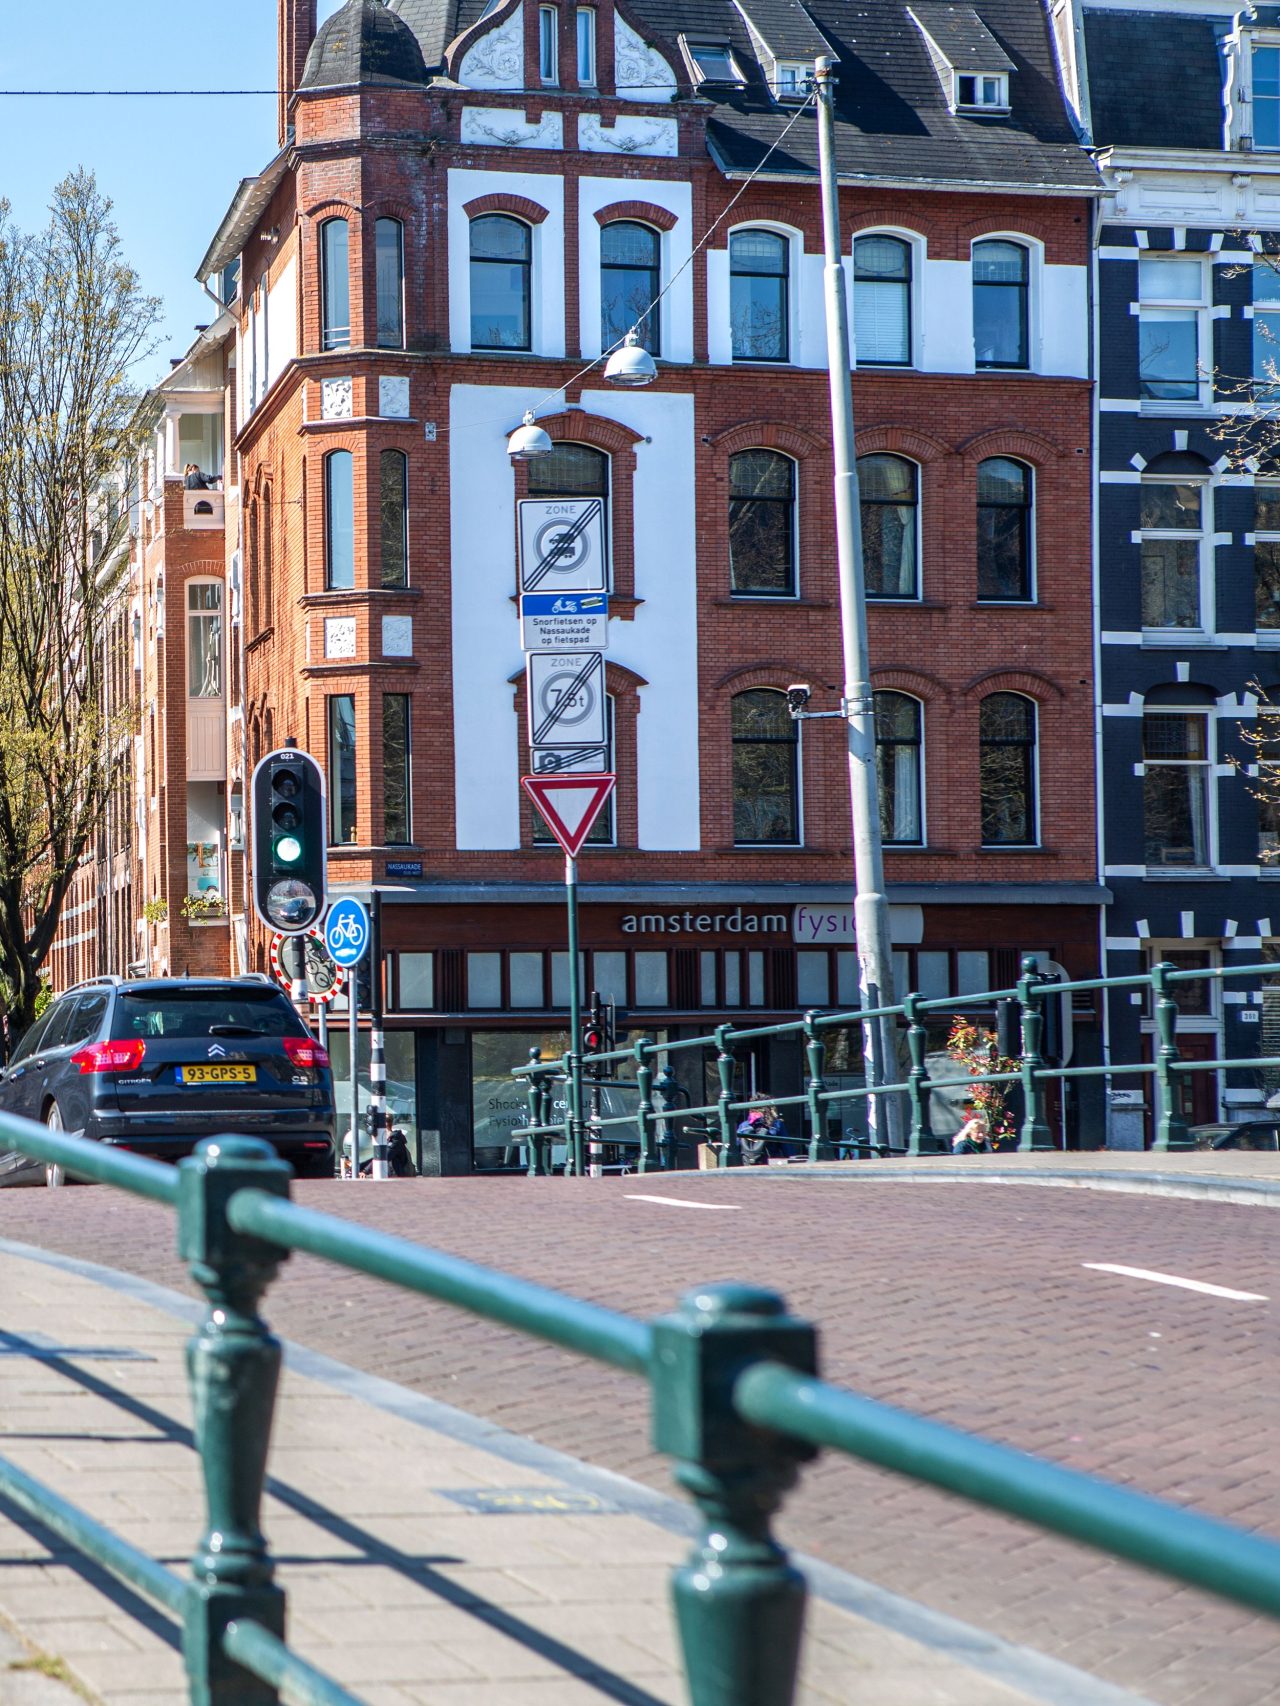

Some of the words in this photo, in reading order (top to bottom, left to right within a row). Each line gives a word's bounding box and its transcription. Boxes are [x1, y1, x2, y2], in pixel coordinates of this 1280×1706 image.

[545, 505, 576, 515] ZONE
[533, 618, 583, 626] Snorfietsen
[586, 617, 597, 627] op
[540, 626, 591, 635] Nassaukade
[541, 637, 552, 645] op
[554, 636, 590, 645] fietspad
[551, 657, 582, 667] ZONE
[621, 907, 787, 933] amsterdam
[187, 1067, 252, 1080] 93-GPS-5
